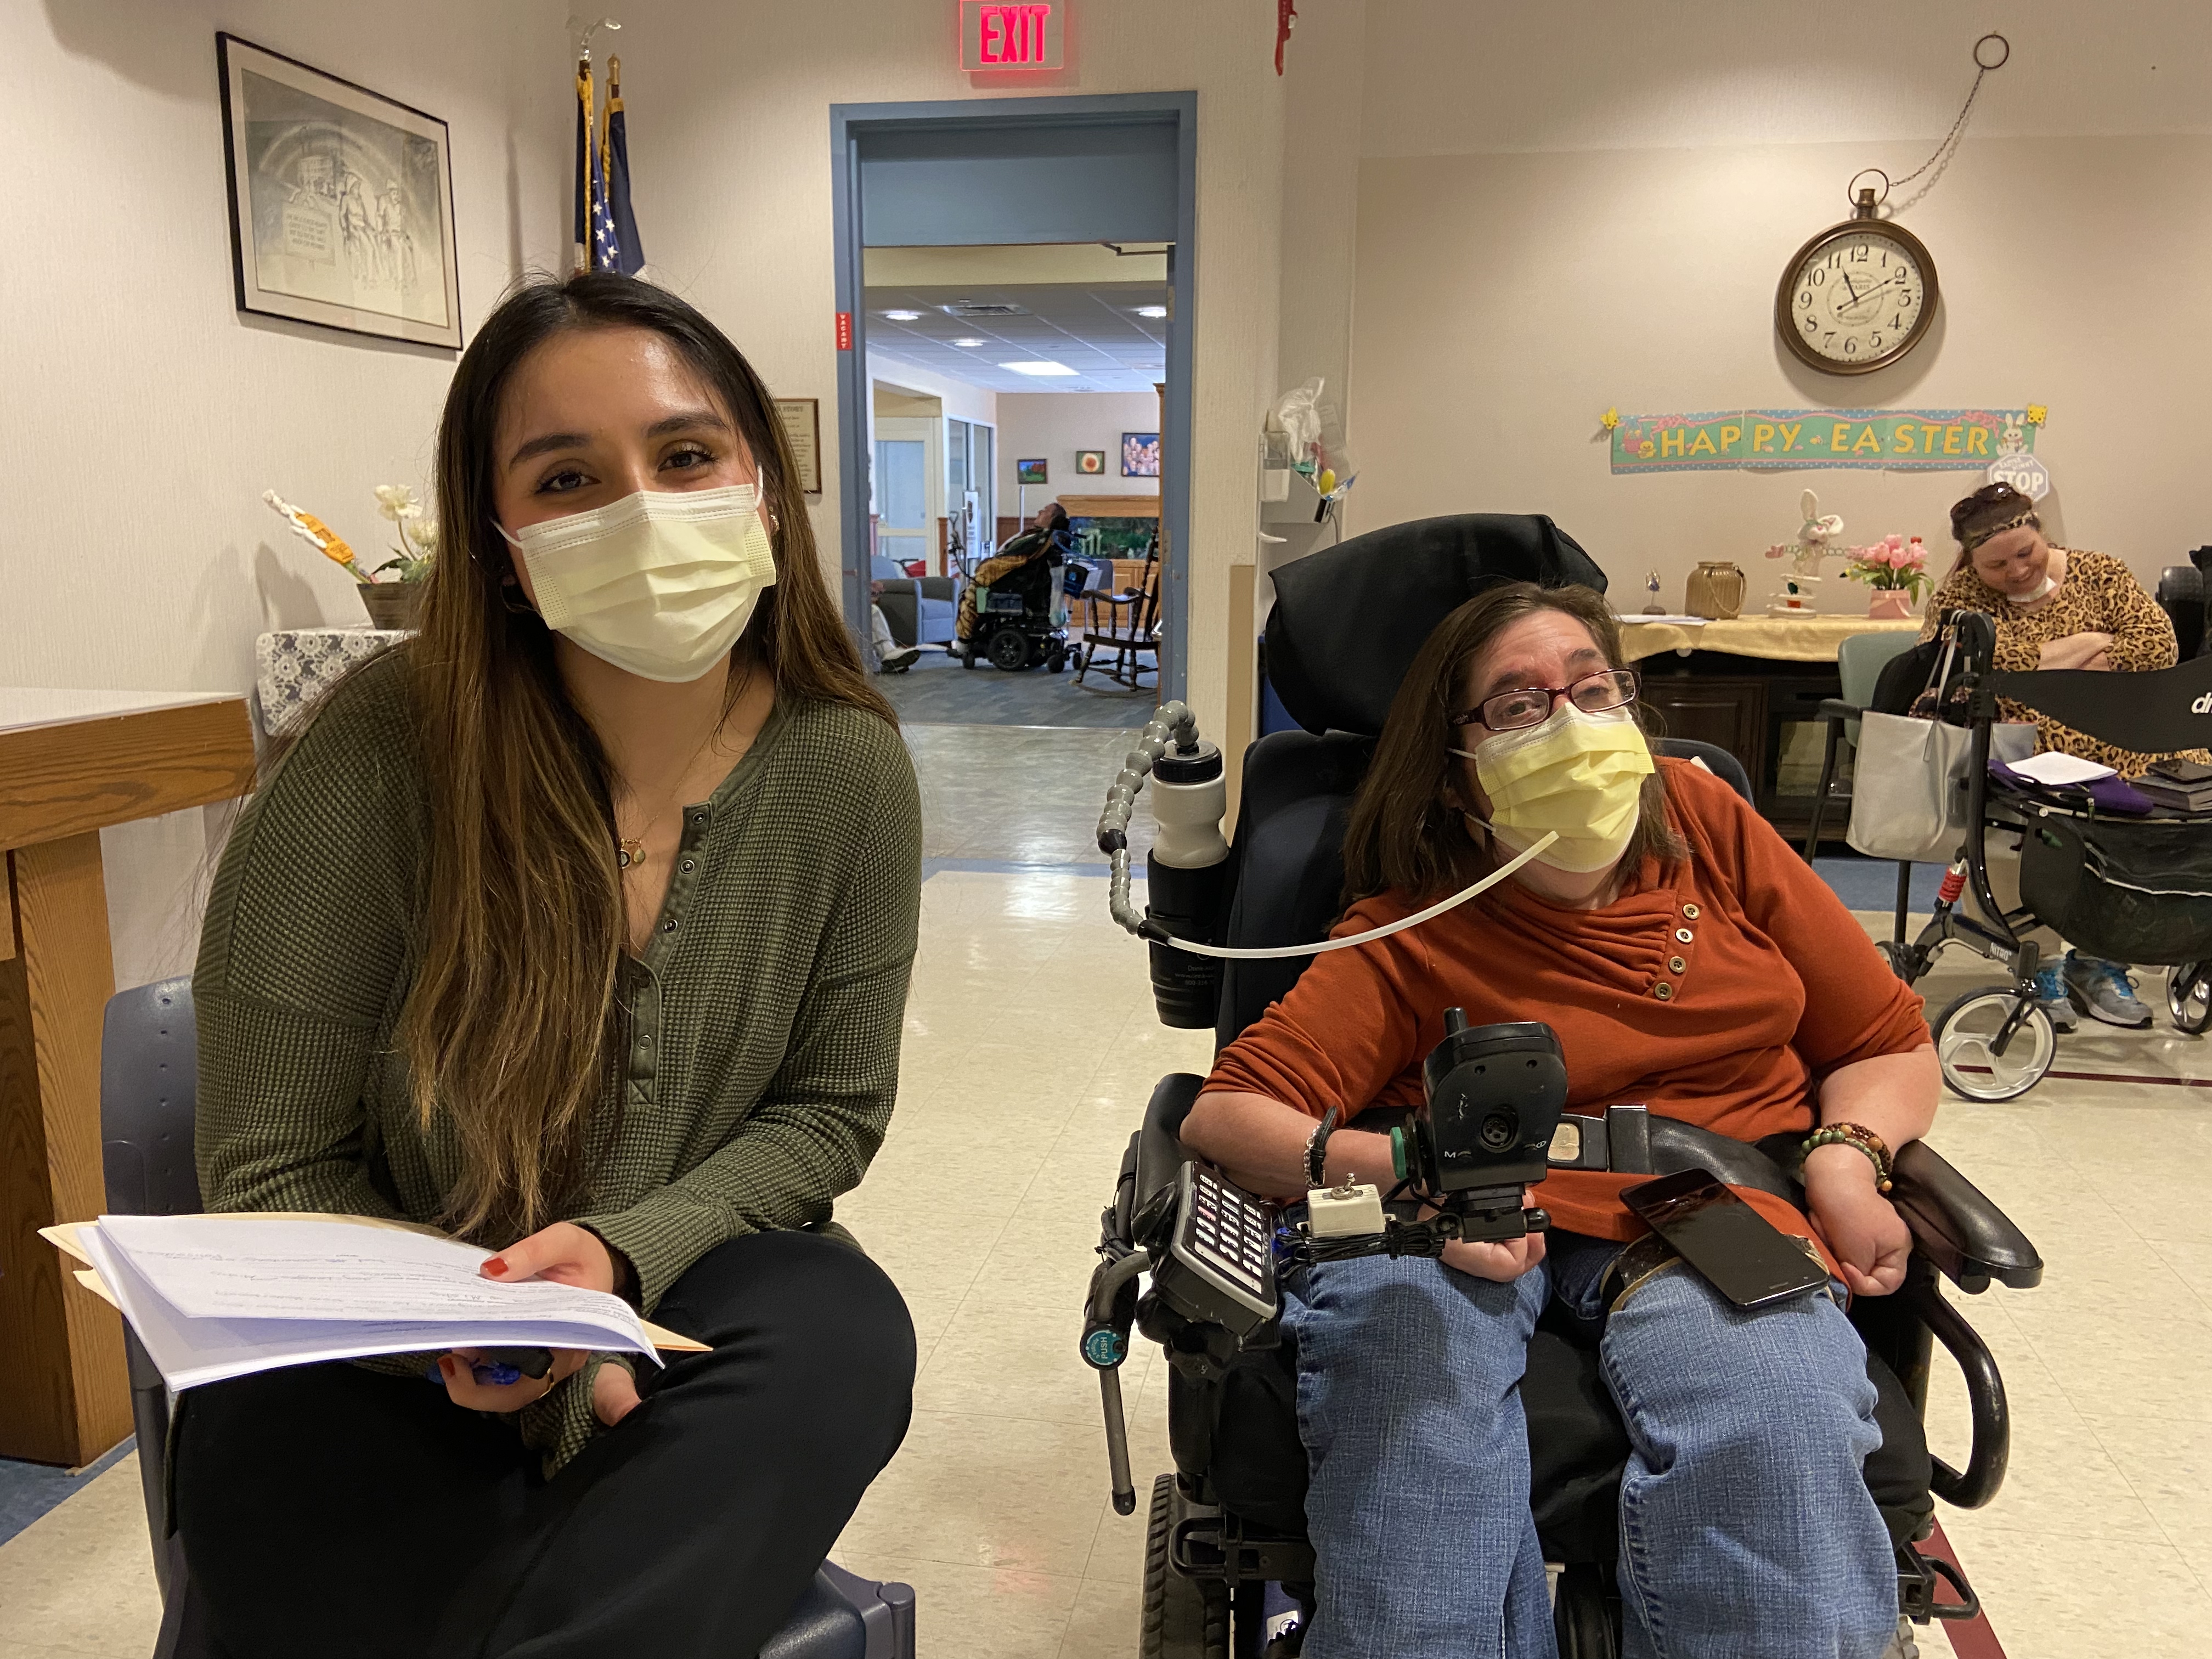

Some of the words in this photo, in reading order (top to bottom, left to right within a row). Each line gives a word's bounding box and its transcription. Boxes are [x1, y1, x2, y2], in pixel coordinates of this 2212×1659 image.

[980, 4, 1051, 64] EXIT
[1827, 251, 1841, 269] 11
[1850, 243, 1869, 262] 12
[1881, 250, 1887, 268] 1
[1807, 268, 1825, 286] 10
[1894, 266, 1906, 285] 2
[1798, 291, 1813, 310] 9
[1898, 289, 1911, 308] 3
[1804, 314, 1818, 332] 8
[1887, 312, 1902, 330] 4
[1823, 331, 1837, 349] 7
[1844, 335, 1858, 354] 6
[1869, 330, 1882, 348] 5
[1661, 423, 1802, 458] HAPPY
[1831, 423, 1988, 456] EASTER
[1994, 470, 2044, 492] STOP
[1990, 942, 2009, 961] NITRO
[1100, 1337, 1108, 1359] PUSH
